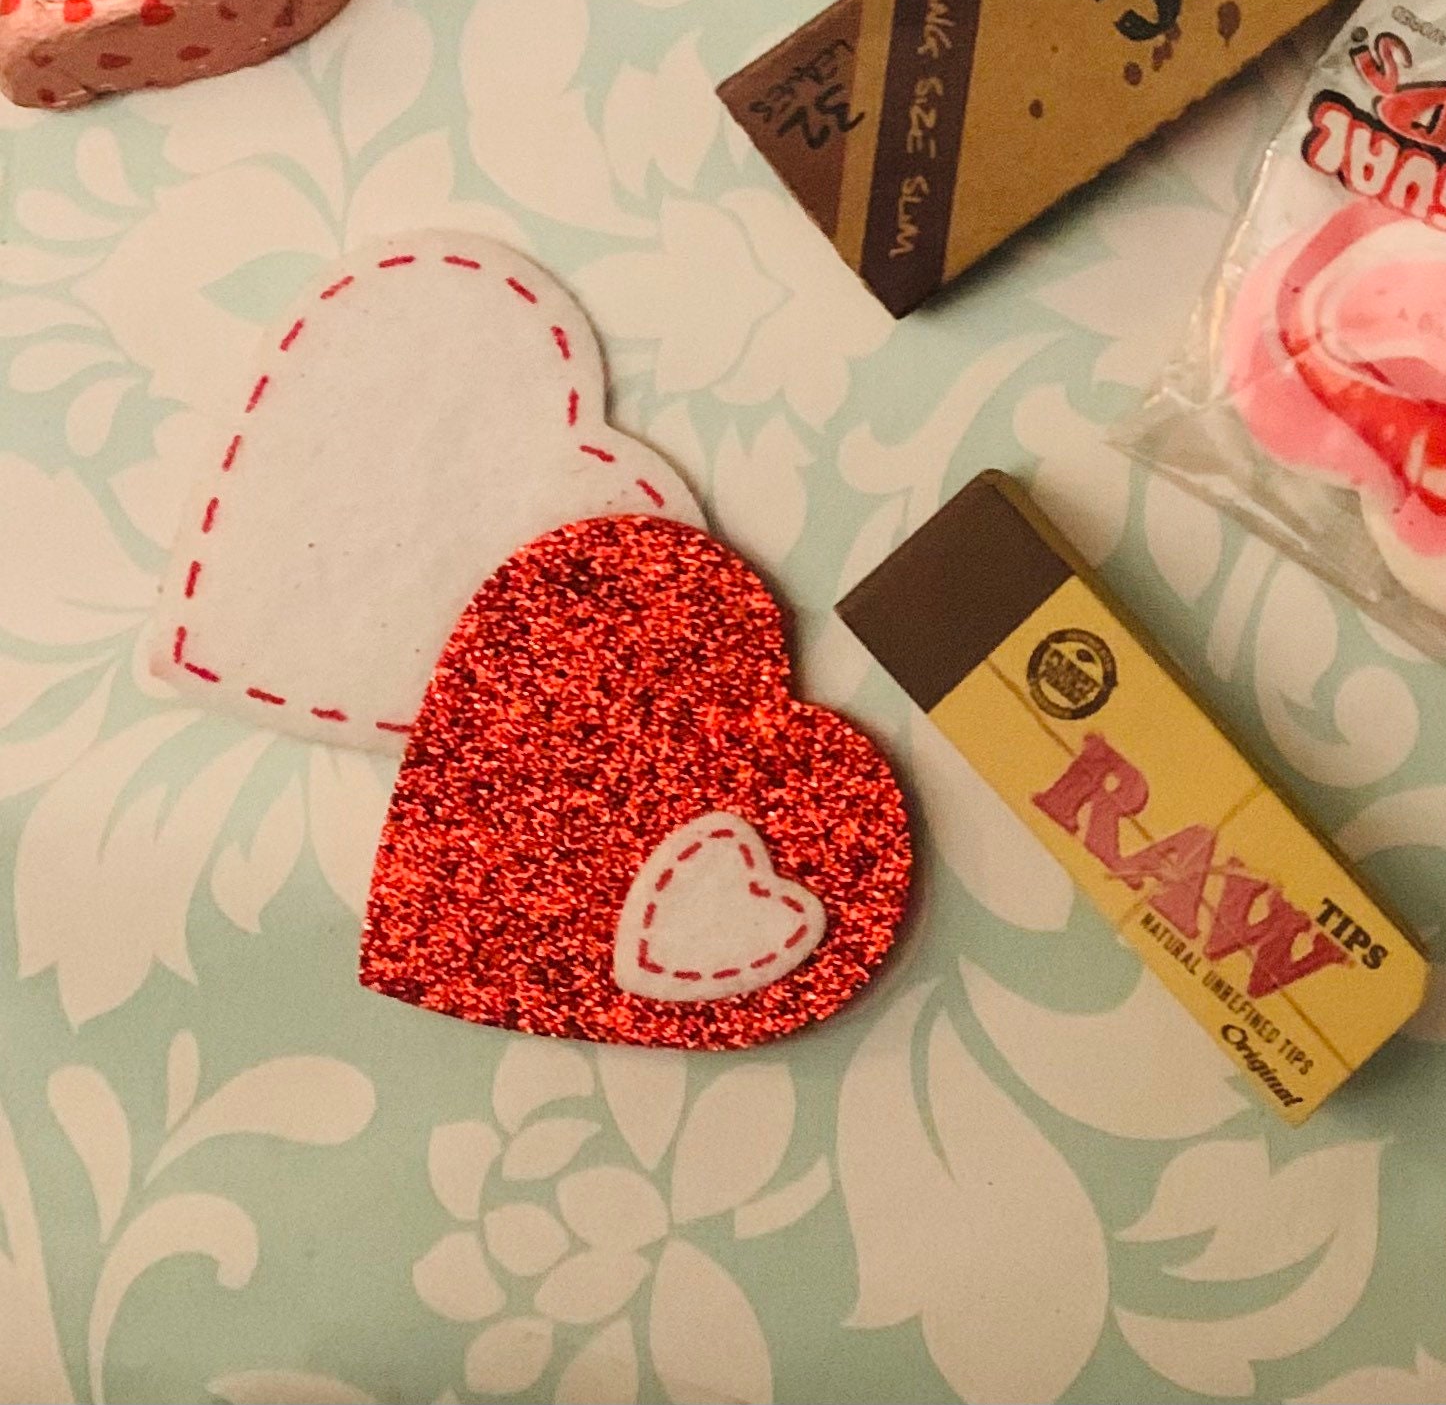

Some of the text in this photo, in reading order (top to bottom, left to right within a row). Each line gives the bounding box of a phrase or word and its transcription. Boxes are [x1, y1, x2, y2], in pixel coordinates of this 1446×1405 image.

[777, 83, 865, 150] 32
[907, 77, 945, 158] SIZE
[1030, 731, 1350, 999] RAW
[1316, 898, 1388, 970] TIPS
[1139, 912, 1202, 976] NATURAL
[1279, 1038, 1315, 1076] TIPS
[1220, 1023, 1304, 1108] Original
